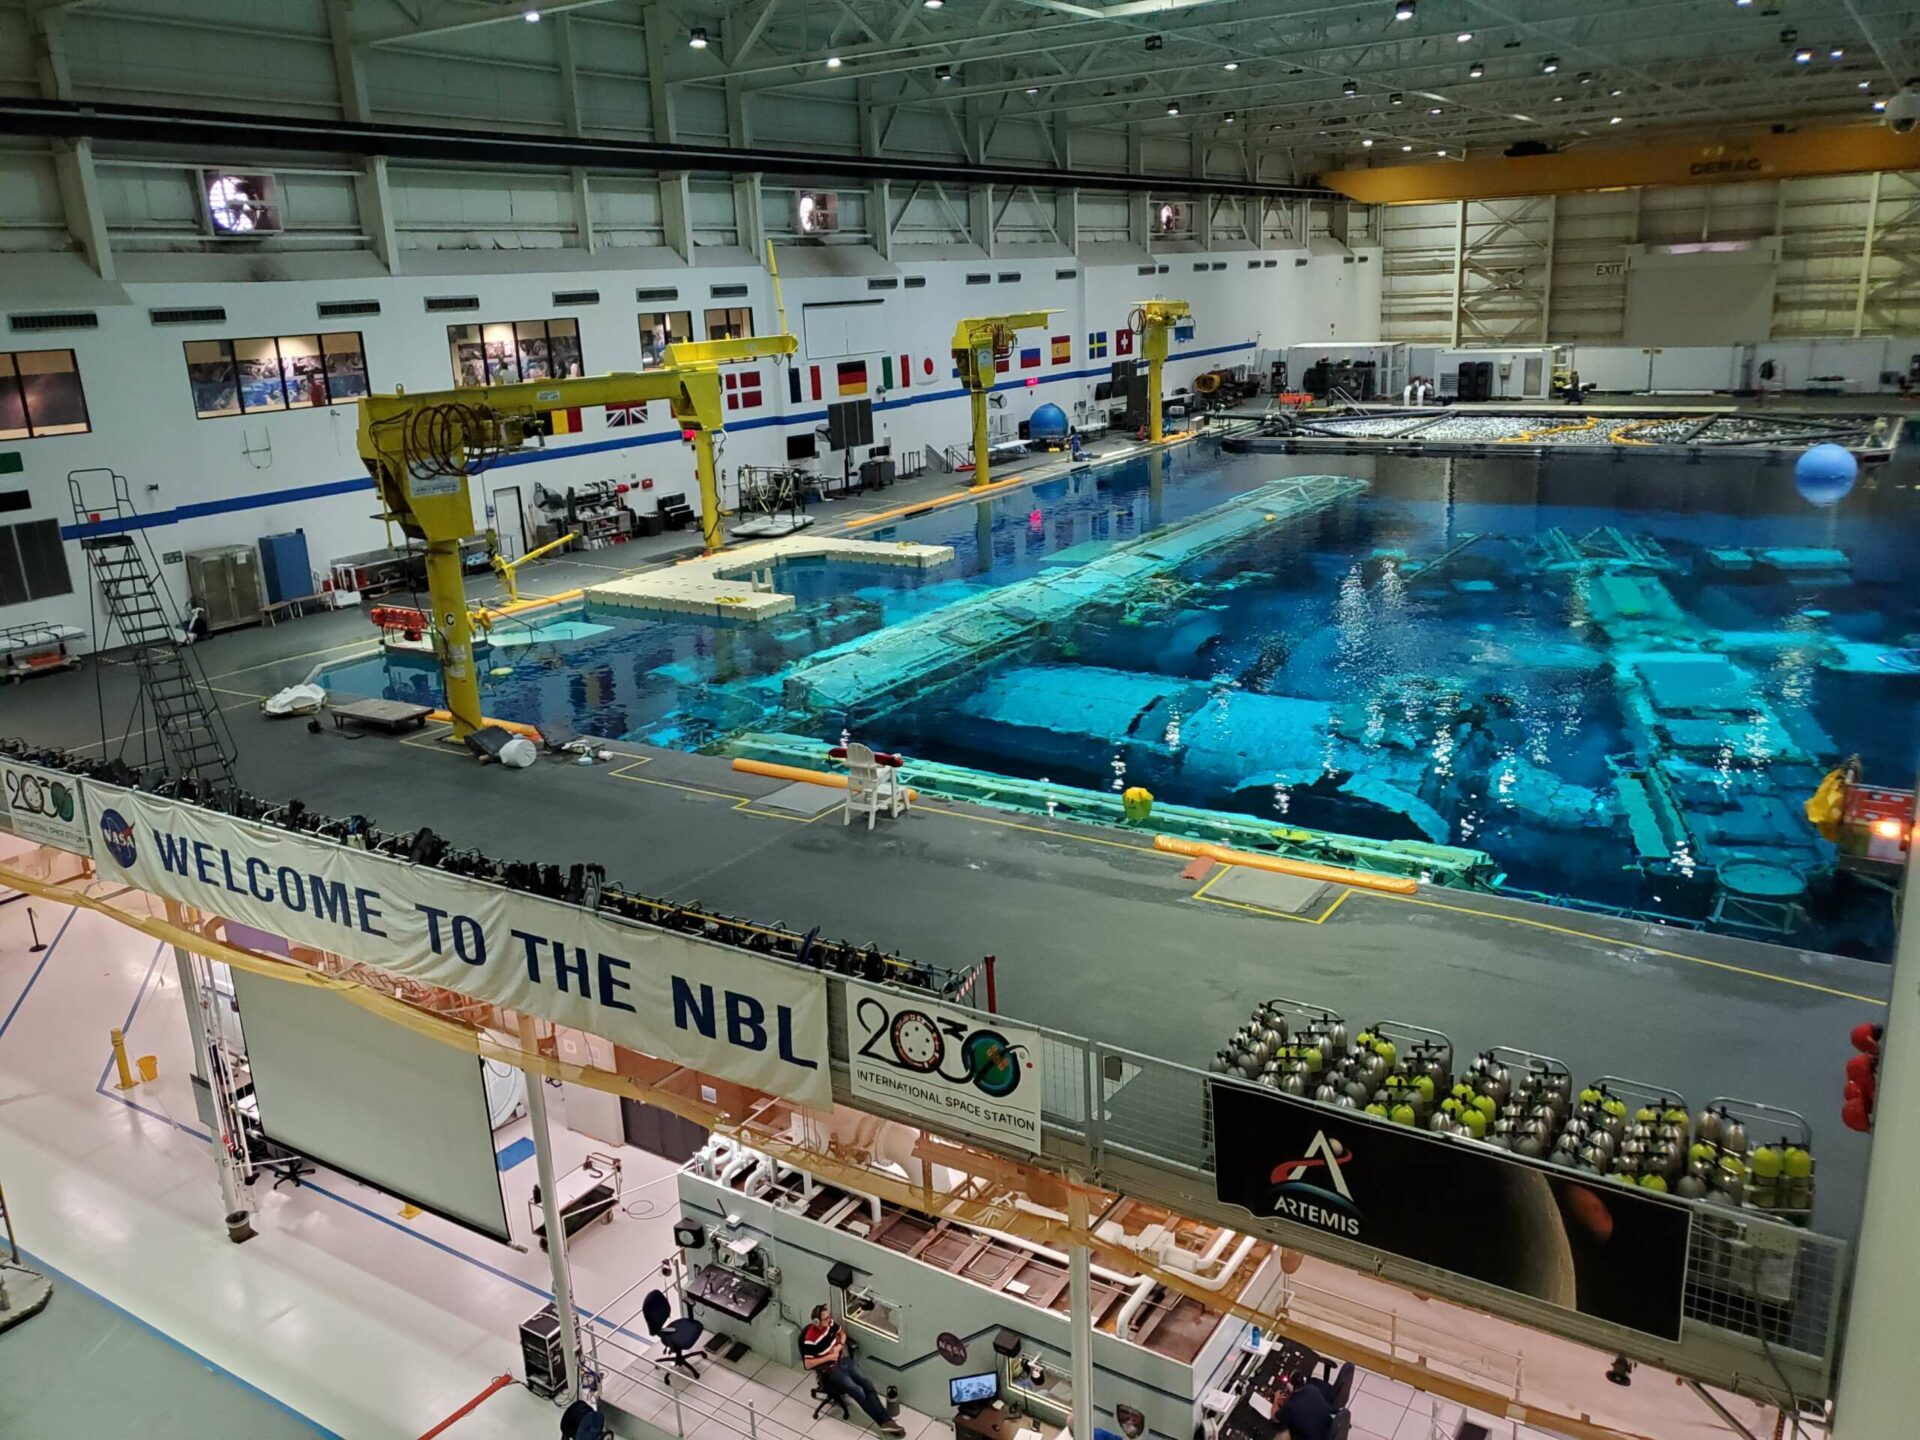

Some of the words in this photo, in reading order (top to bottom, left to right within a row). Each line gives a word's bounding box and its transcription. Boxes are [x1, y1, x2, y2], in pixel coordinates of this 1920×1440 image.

[1596, 264, 1623, 276] EXIT
[445, 613, 455, 626] C
[103, 828, 136, 849] NASA
[153, 830, 388, 938] WELCOME
[414, 902, 487, 967] TO
[511, 928, 637, 1014] THE
[671, 974, 818, 1071] NBL
[856, 1069, 943, 1105] INTERNATIONAL
[945, 1096, 982, 1117] SPACE
[983, 1109, 1036, 1132] STATION
[1273, 1195, 1360, 1236] ARTEMIS
[938, 1340, 966, 1359] NASA
